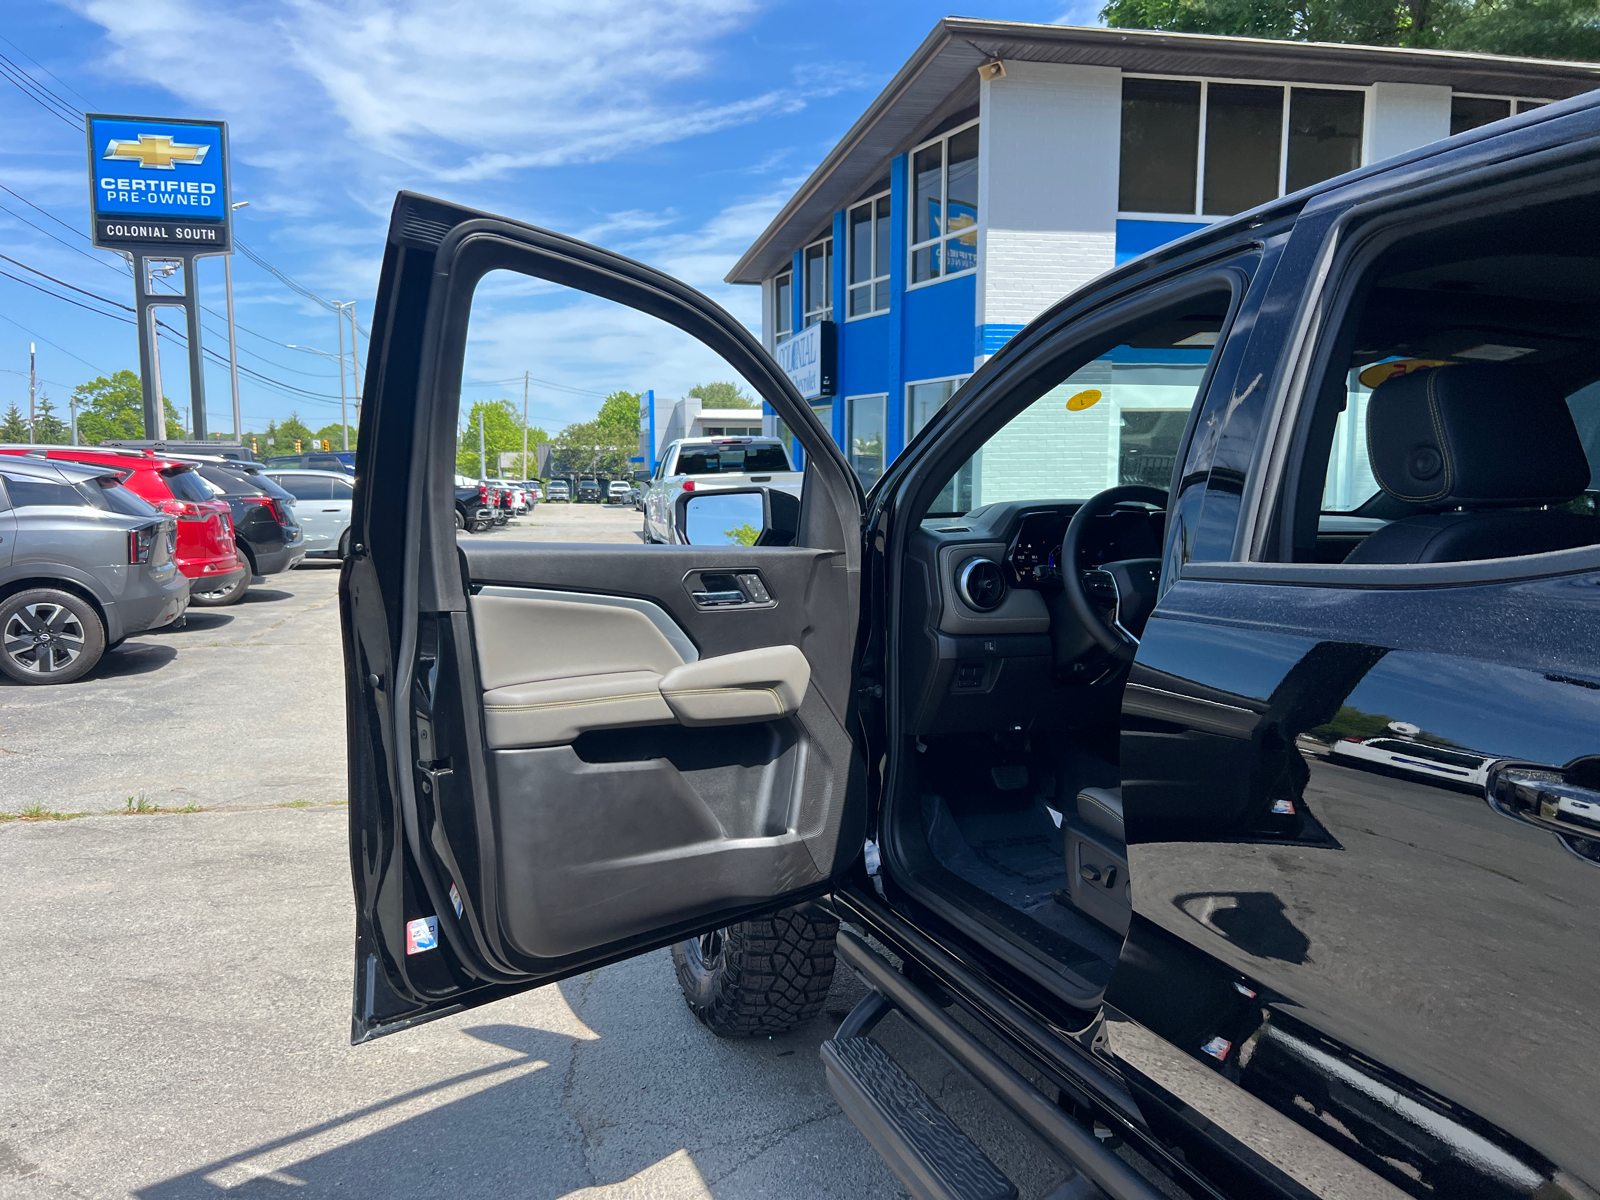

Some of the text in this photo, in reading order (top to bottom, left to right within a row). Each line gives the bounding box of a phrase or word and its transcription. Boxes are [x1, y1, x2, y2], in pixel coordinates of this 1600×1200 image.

[100, 178, 216, 194] CERTIFIED
[107, 191, 211, 206] PRE-OWNED
[106, 224, 216, 240] COLONIAL SOUTH
